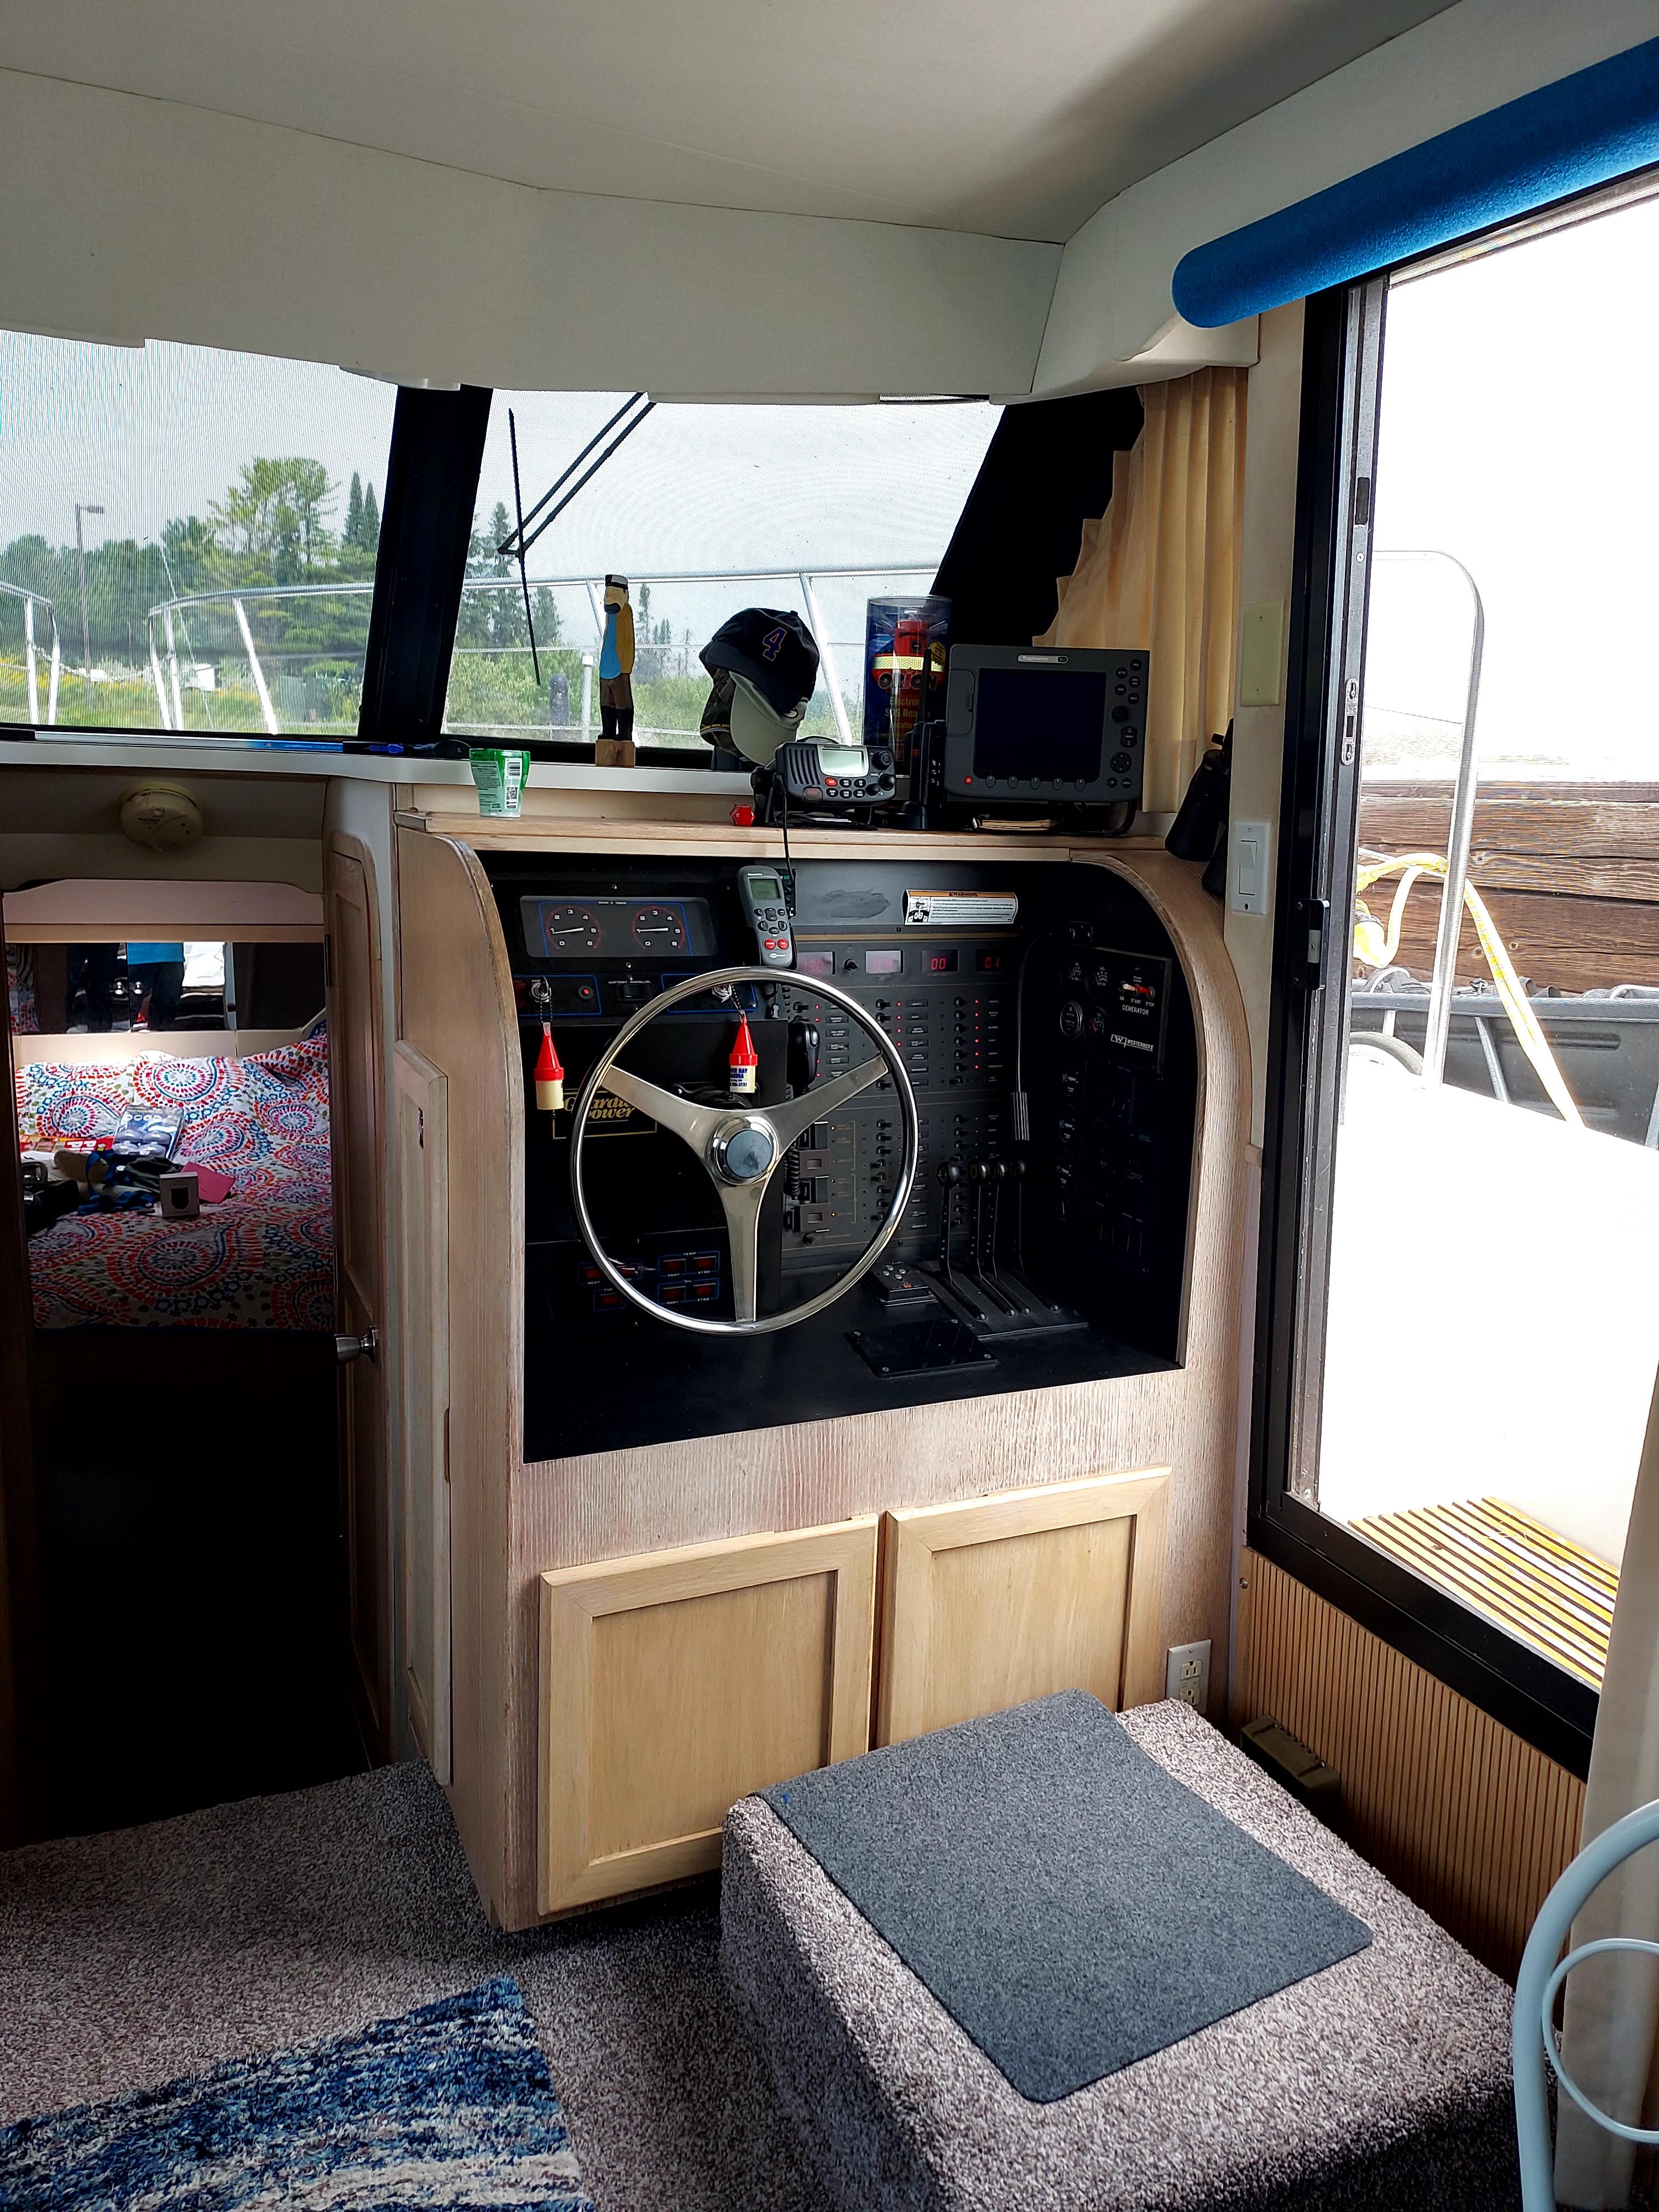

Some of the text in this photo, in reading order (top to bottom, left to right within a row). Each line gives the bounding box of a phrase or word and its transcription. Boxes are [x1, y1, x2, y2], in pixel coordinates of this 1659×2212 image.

[763, 627, 787, 662] 4
[1122, 1004, 1149, 1016] GENERATOR
[1127, 1039, 1154, 1050] WESTERBEKE
